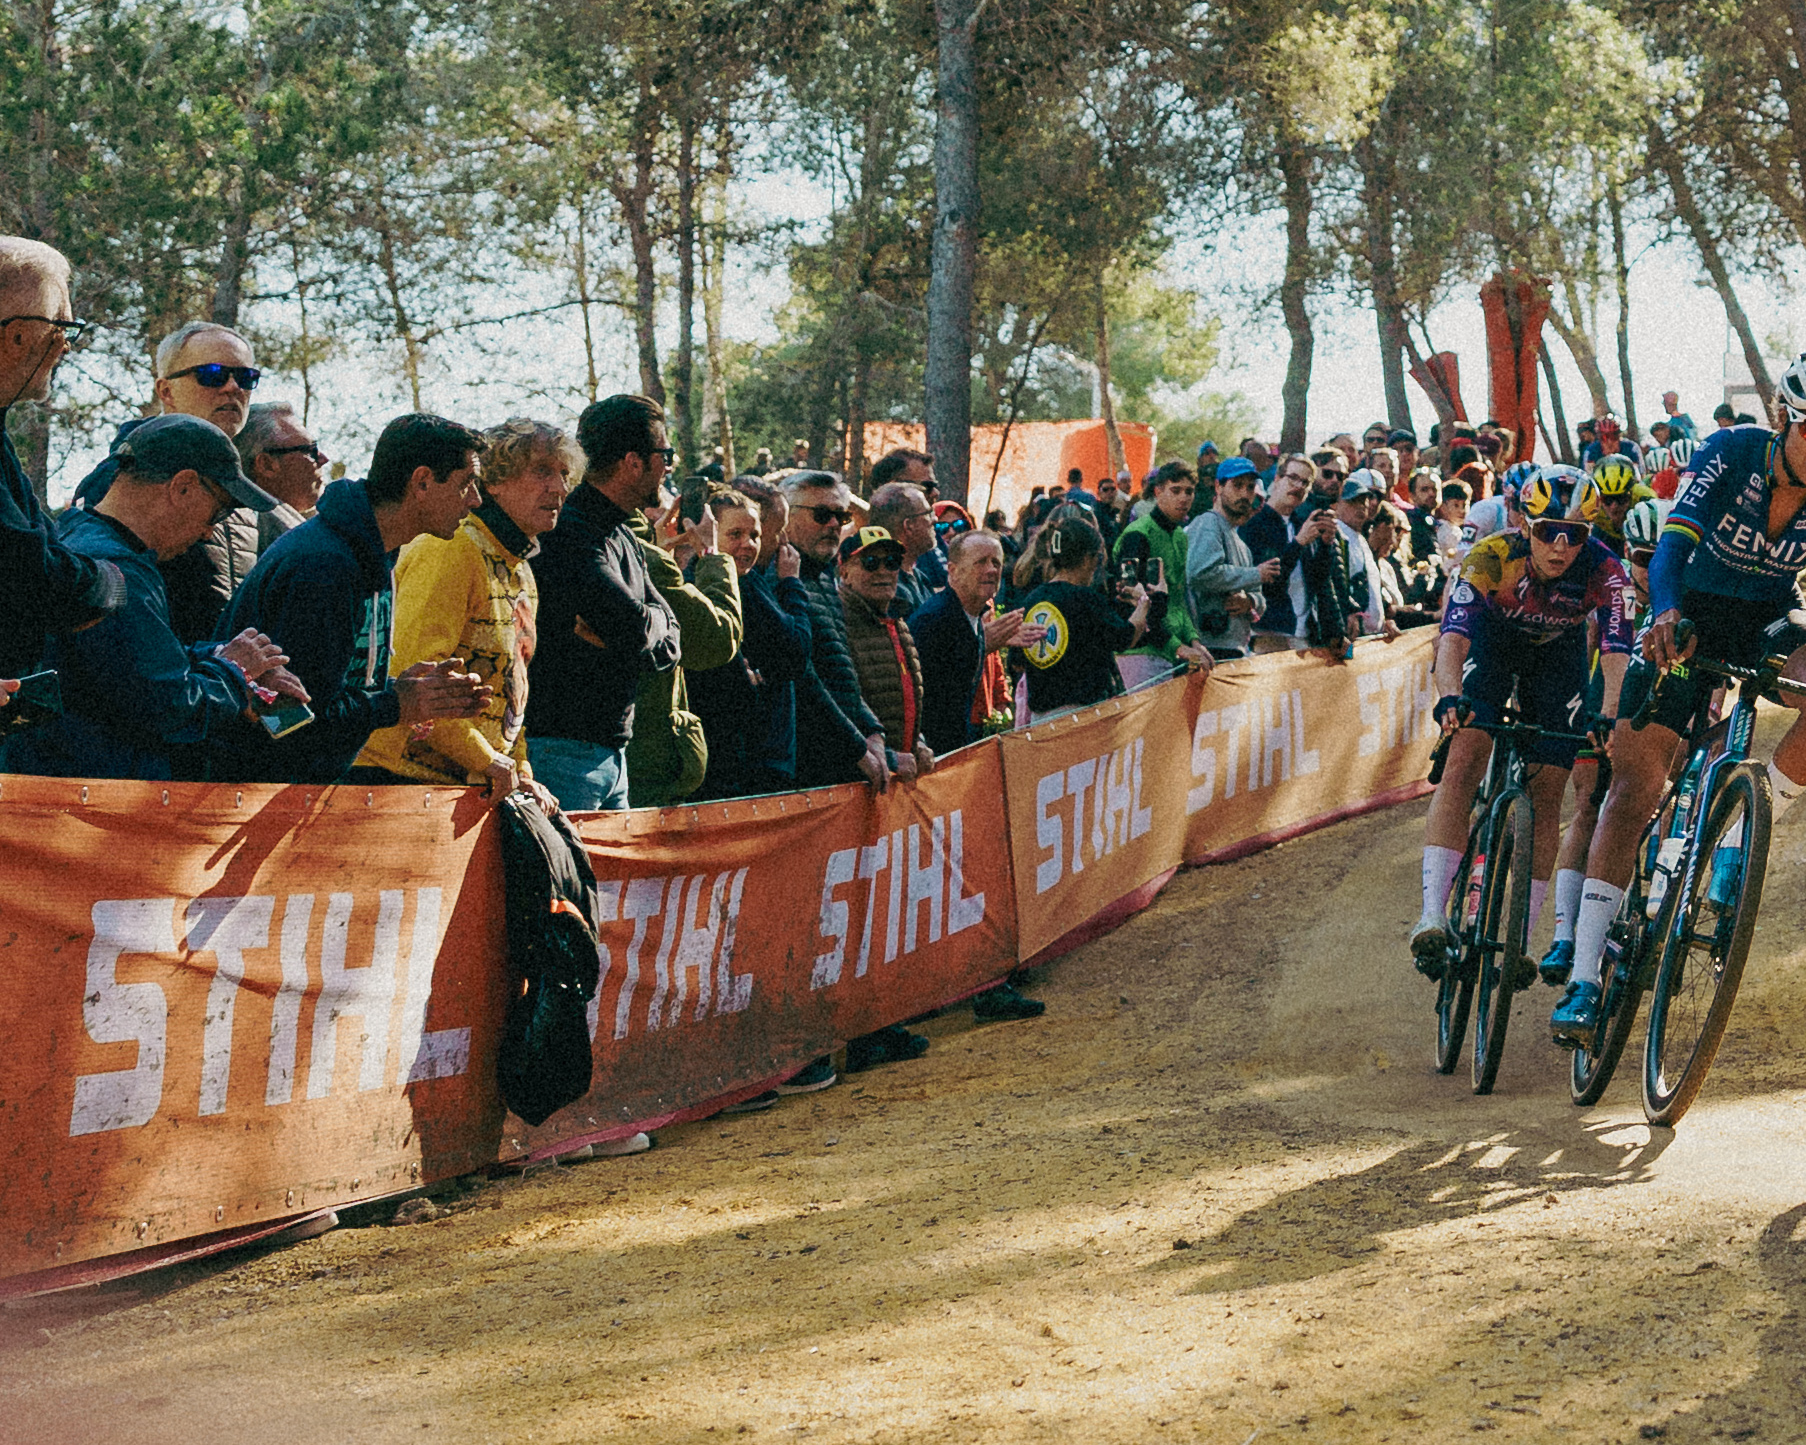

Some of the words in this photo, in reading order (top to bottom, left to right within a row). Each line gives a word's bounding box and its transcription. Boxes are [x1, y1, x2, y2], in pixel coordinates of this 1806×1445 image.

[1682, 453, 1728, 507] FENIX
[1711, 531, 1759, 561] INNOVATIVE
[1522, 612, 1571, 626] sdwo
[1608, 590, 1623, 636] sdworx
[1627, 595, 1635, 611] 7
[1186, 687, 1320, 816] STIHL
[1036, 736, 1152, 895] STIHL
[810, 809, 986, 991] STIHL
[69, 886, 472, 1138] STIHL
